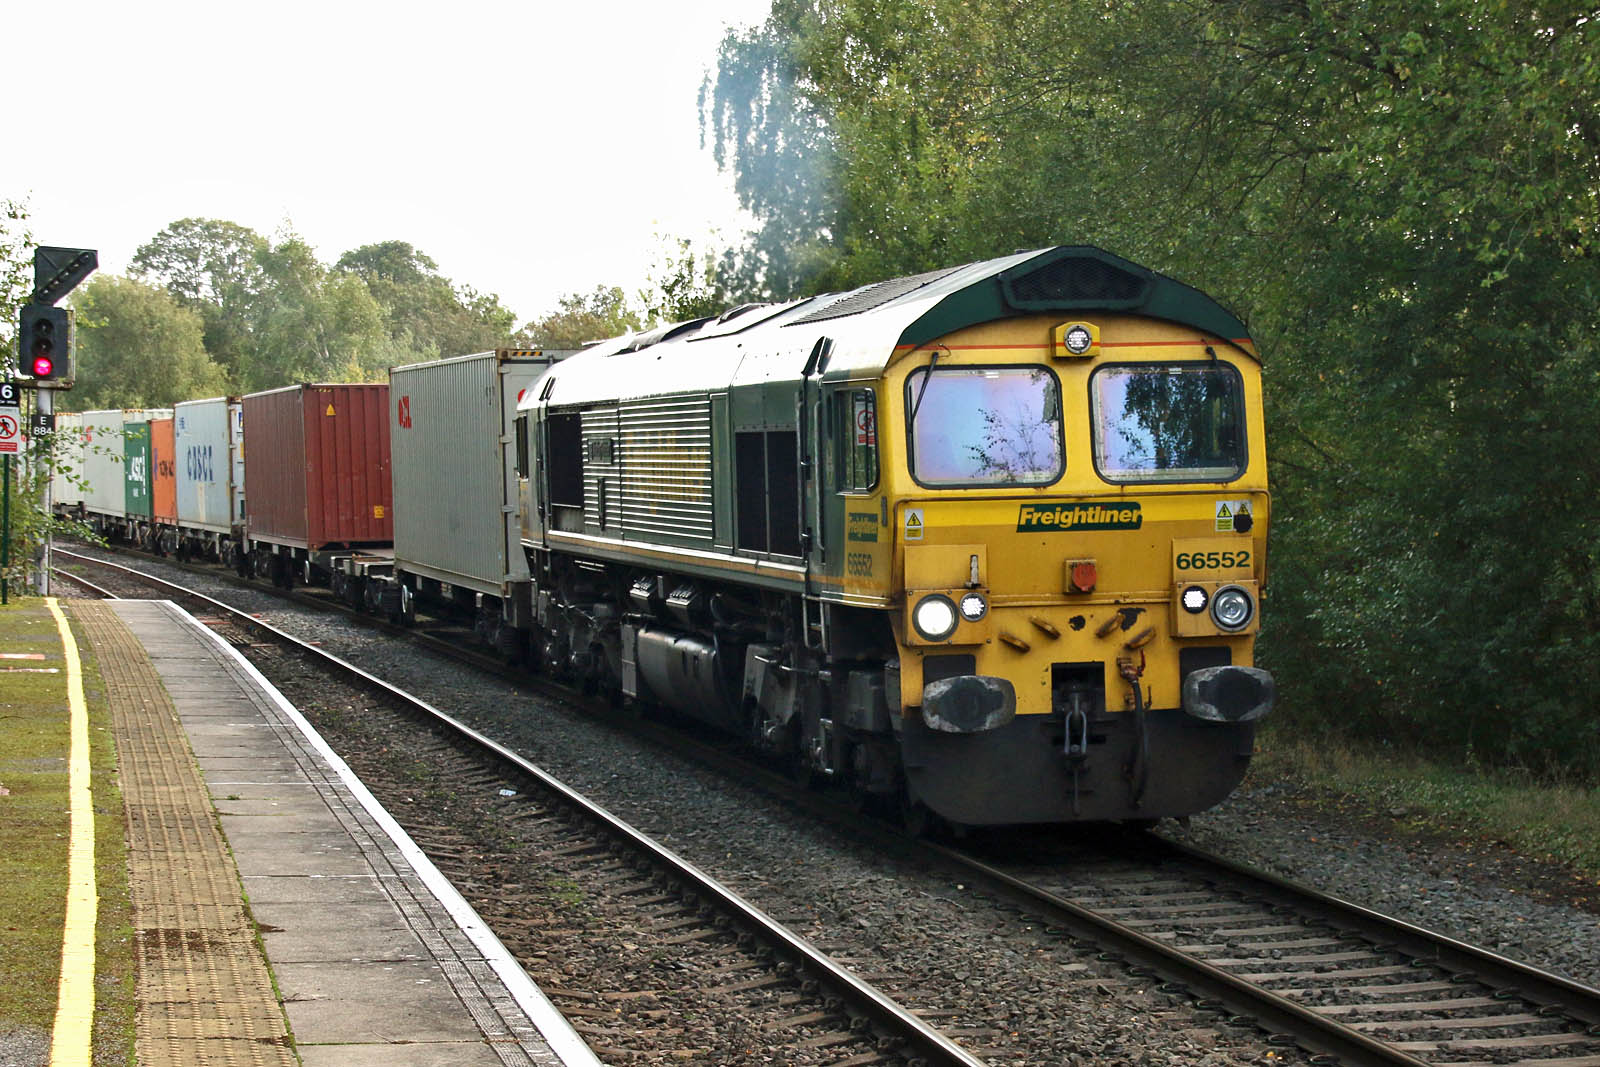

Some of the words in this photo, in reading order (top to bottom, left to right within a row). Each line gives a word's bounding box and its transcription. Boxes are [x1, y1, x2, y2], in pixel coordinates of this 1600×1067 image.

[1, 384, 14, 399] 6
[40, 416, 48, 425] E
[1019, 506, 1142, 529] Freightliner
[1176, 550, 1251, 570] 66552
